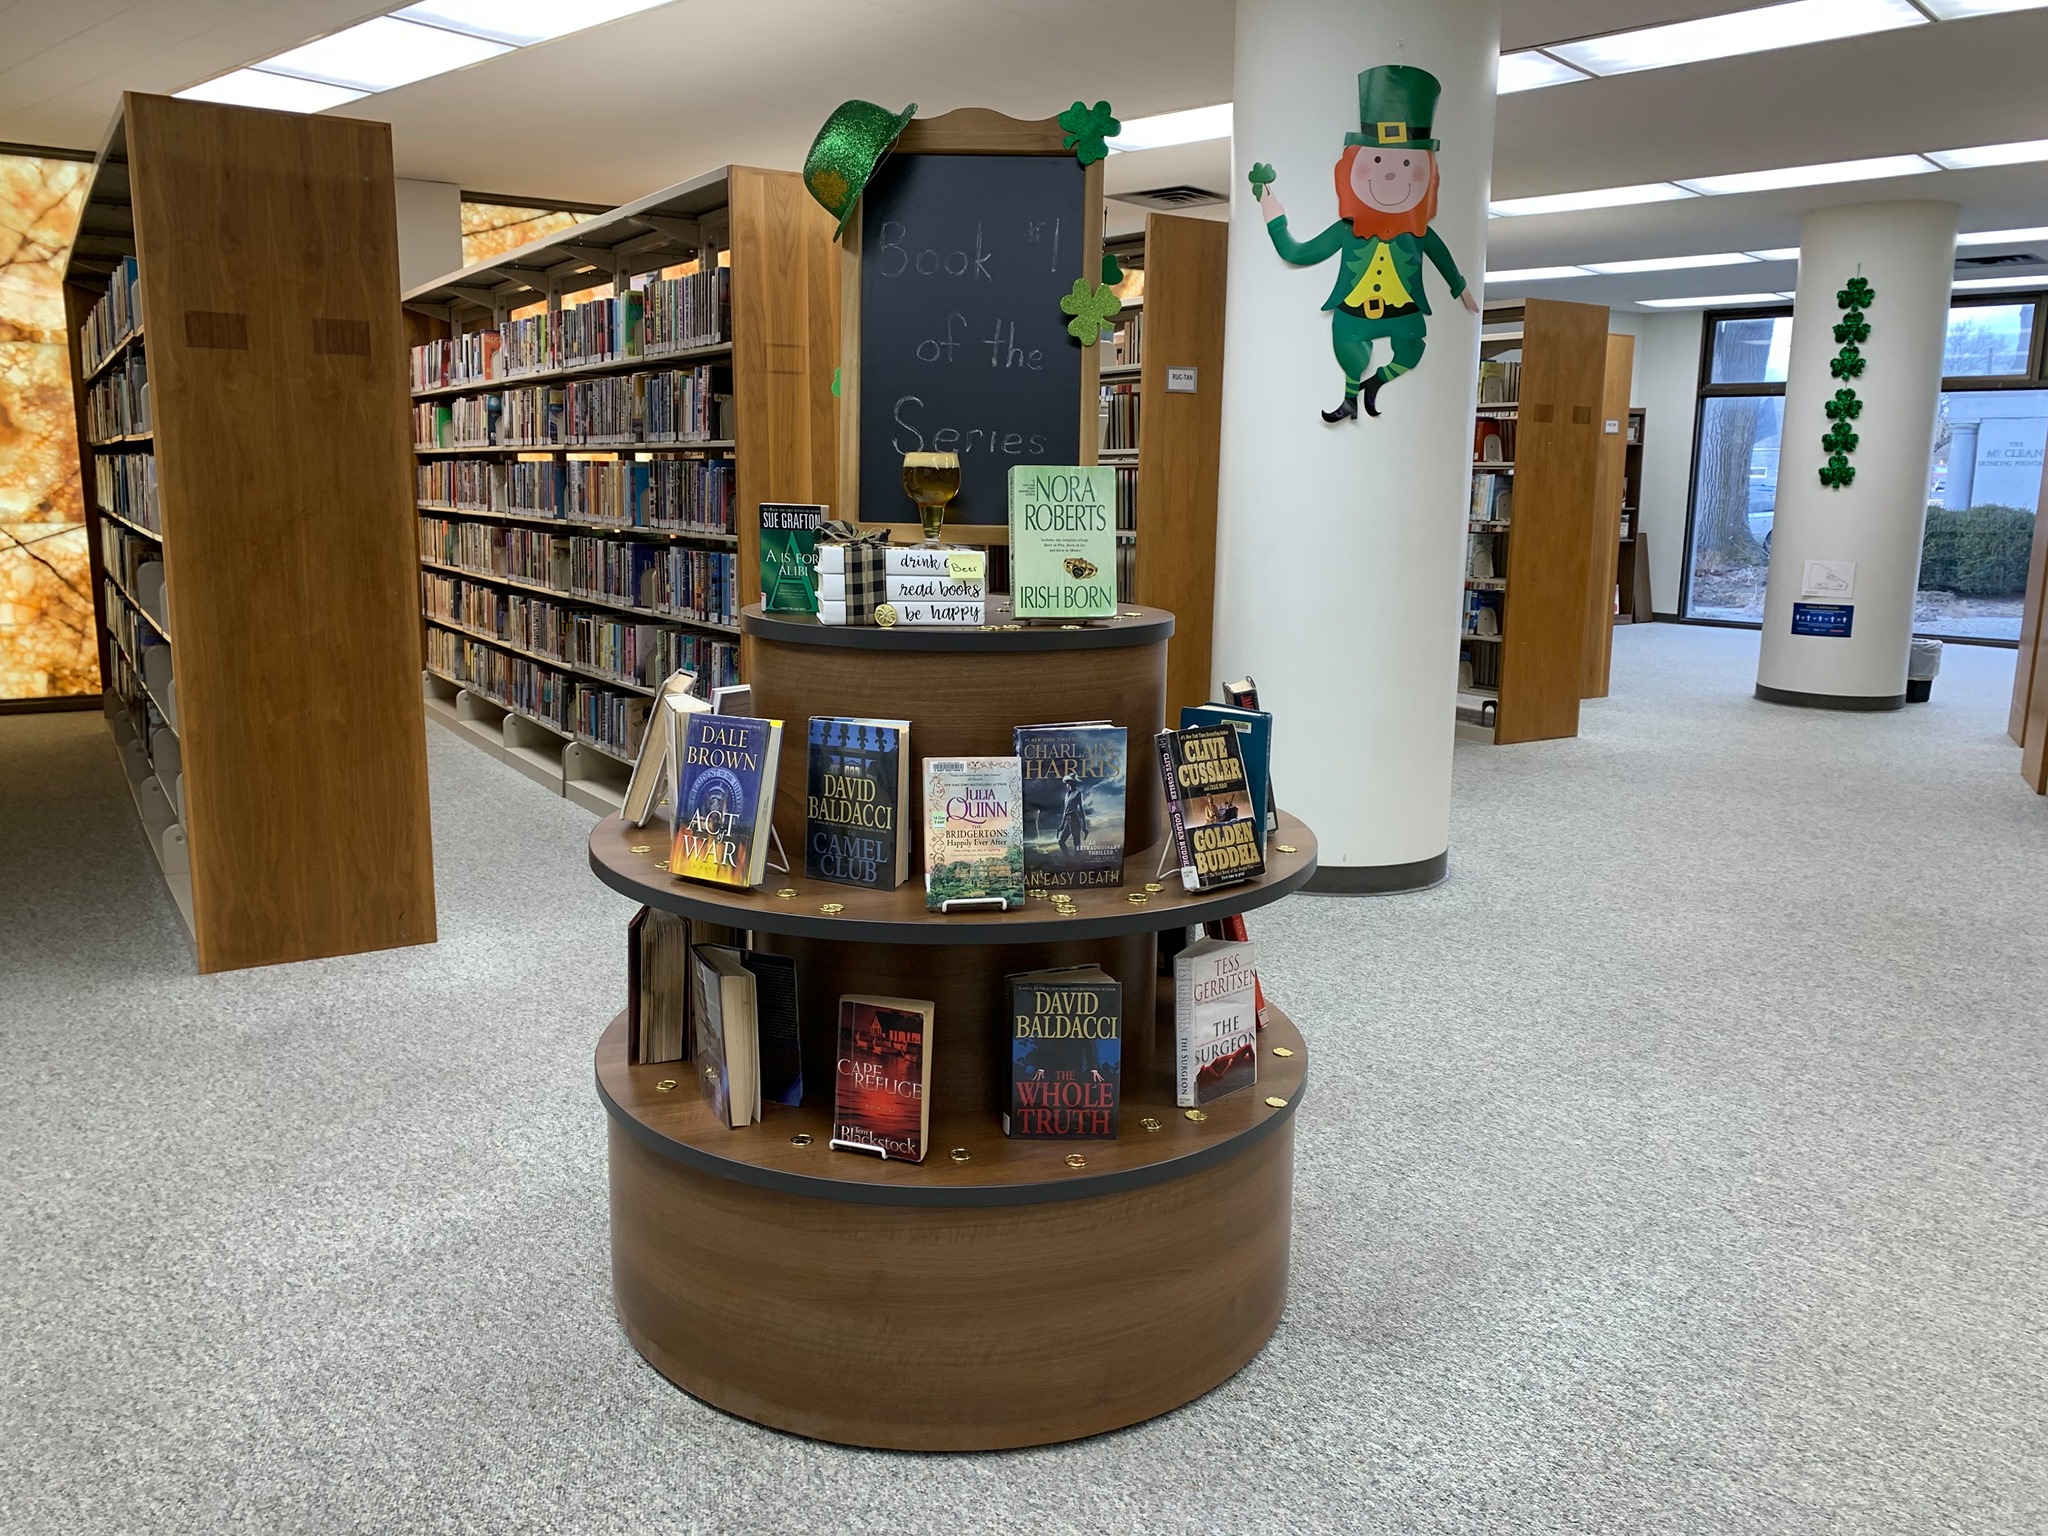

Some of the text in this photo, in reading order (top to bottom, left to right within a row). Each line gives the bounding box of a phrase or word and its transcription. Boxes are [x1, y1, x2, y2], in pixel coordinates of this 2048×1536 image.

[879, 221, 992, 282] Book
[916, 311, 1043, 371] of the
[1171, 373, 1194, 381] RUC-TAN
[891, 395, 1047, 456] Series
[1036, 475, 1096, 502] NORA
[763, 511, 821, 530] SUE GRAFTON
[1025, 504, 1106, 531] ROBERTS
[765, 549, 819, 565] A IS FOR
[900, 554, 941, 571] drink
[950, 563, 978, 573] Beer
[778, 565, 808, 577] ALIBI
[898, 580, 982, 598] read books
[1020, 585, 1112, 609] IRISH BORN
[904, 605, 981, 625] be happy
[701, 725, 749, 748] DALE
[1184, 737, 1228, 763] CLIVE
[687, 746, 758, 772] BROWN
[1024, 757, 1121, 780] HARRIS
[1178, 757, 1242, 787] CUSSLER
[823, 774, 876, 802] DAVID
[1163, 752, 1178, 801] CLIVE CUSSLER
[965, 787, 996, 801] JULIA
[686, 808, 740, 837] ACT
[807, 796, 893, 830] BALDACCI
[946, 796, 1008, 824] QUINN
[716, 829, 727, 844] of
[945, 829, 1010, 838] BRIDGERTONS:
[1174, 813, 1185, 840] GOLDEN
[1193, 821, 1254, 852] GOLDEN
[683, 834, 738, 868] WAR
[813, 832, 889, 863] CAMEL
[946, 839, 972, 849] Happily
[820, 854, 877, 883] CLUB
[1194, 842, 1261, 875] BUDDHA
[1023, 870, 1119, 886] AN EASY DEATH
[1214, 953, 1240, 977] TESS
[1193, 969, 1256, 1002] GERRITSEN
[1035, 991, 1099, 1015] DAVID
[1177, 982, 1192, 1034] GERRITSEN
[1015, 1015, 1118, 1040] BALDACCI
[1212, 1015, 1239, 1038] THE
[1195, 1032, 1255, 1066] SURGEON
[837, 1058, 882, 1078] CAPE
[1055, 1070, 1076, 1080] THE
[1181, 1054, 1189, 1095] SURGEON
[854, 1072, 922, 1100] REFUGE
[1016, 1081, 1114, 1108] WHOLE
[1017, 1108, 1111, 1135] TRUTH
[840, 1125, 916, 1155] Blackstock
